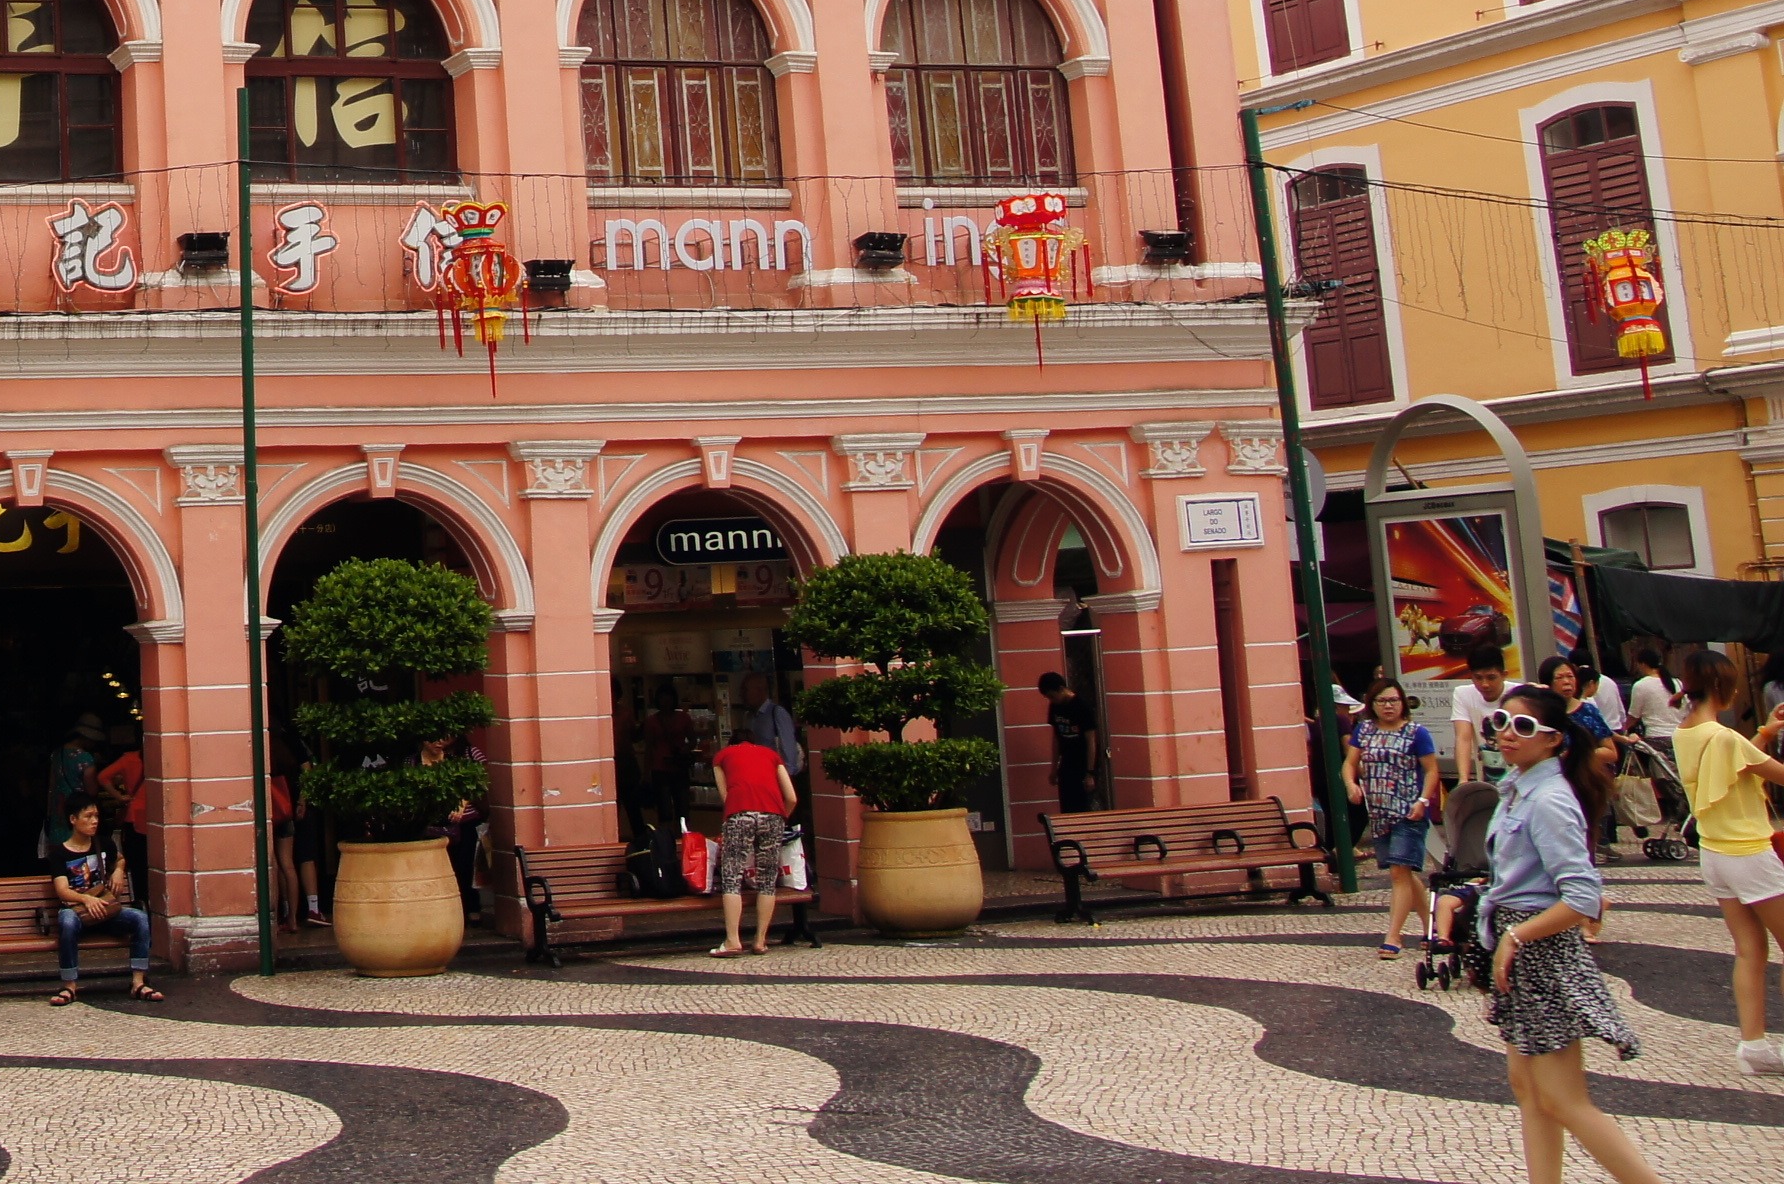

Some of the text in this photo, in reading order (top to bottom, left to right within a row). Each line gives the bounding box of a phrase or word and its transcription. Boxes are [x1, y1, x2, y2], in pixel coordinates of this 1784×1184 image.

[1202, 508, 1223, 517] LARGO
[1209, 518, 1219, 526] DO
[1203, 527, 1227, 535] SENADO
